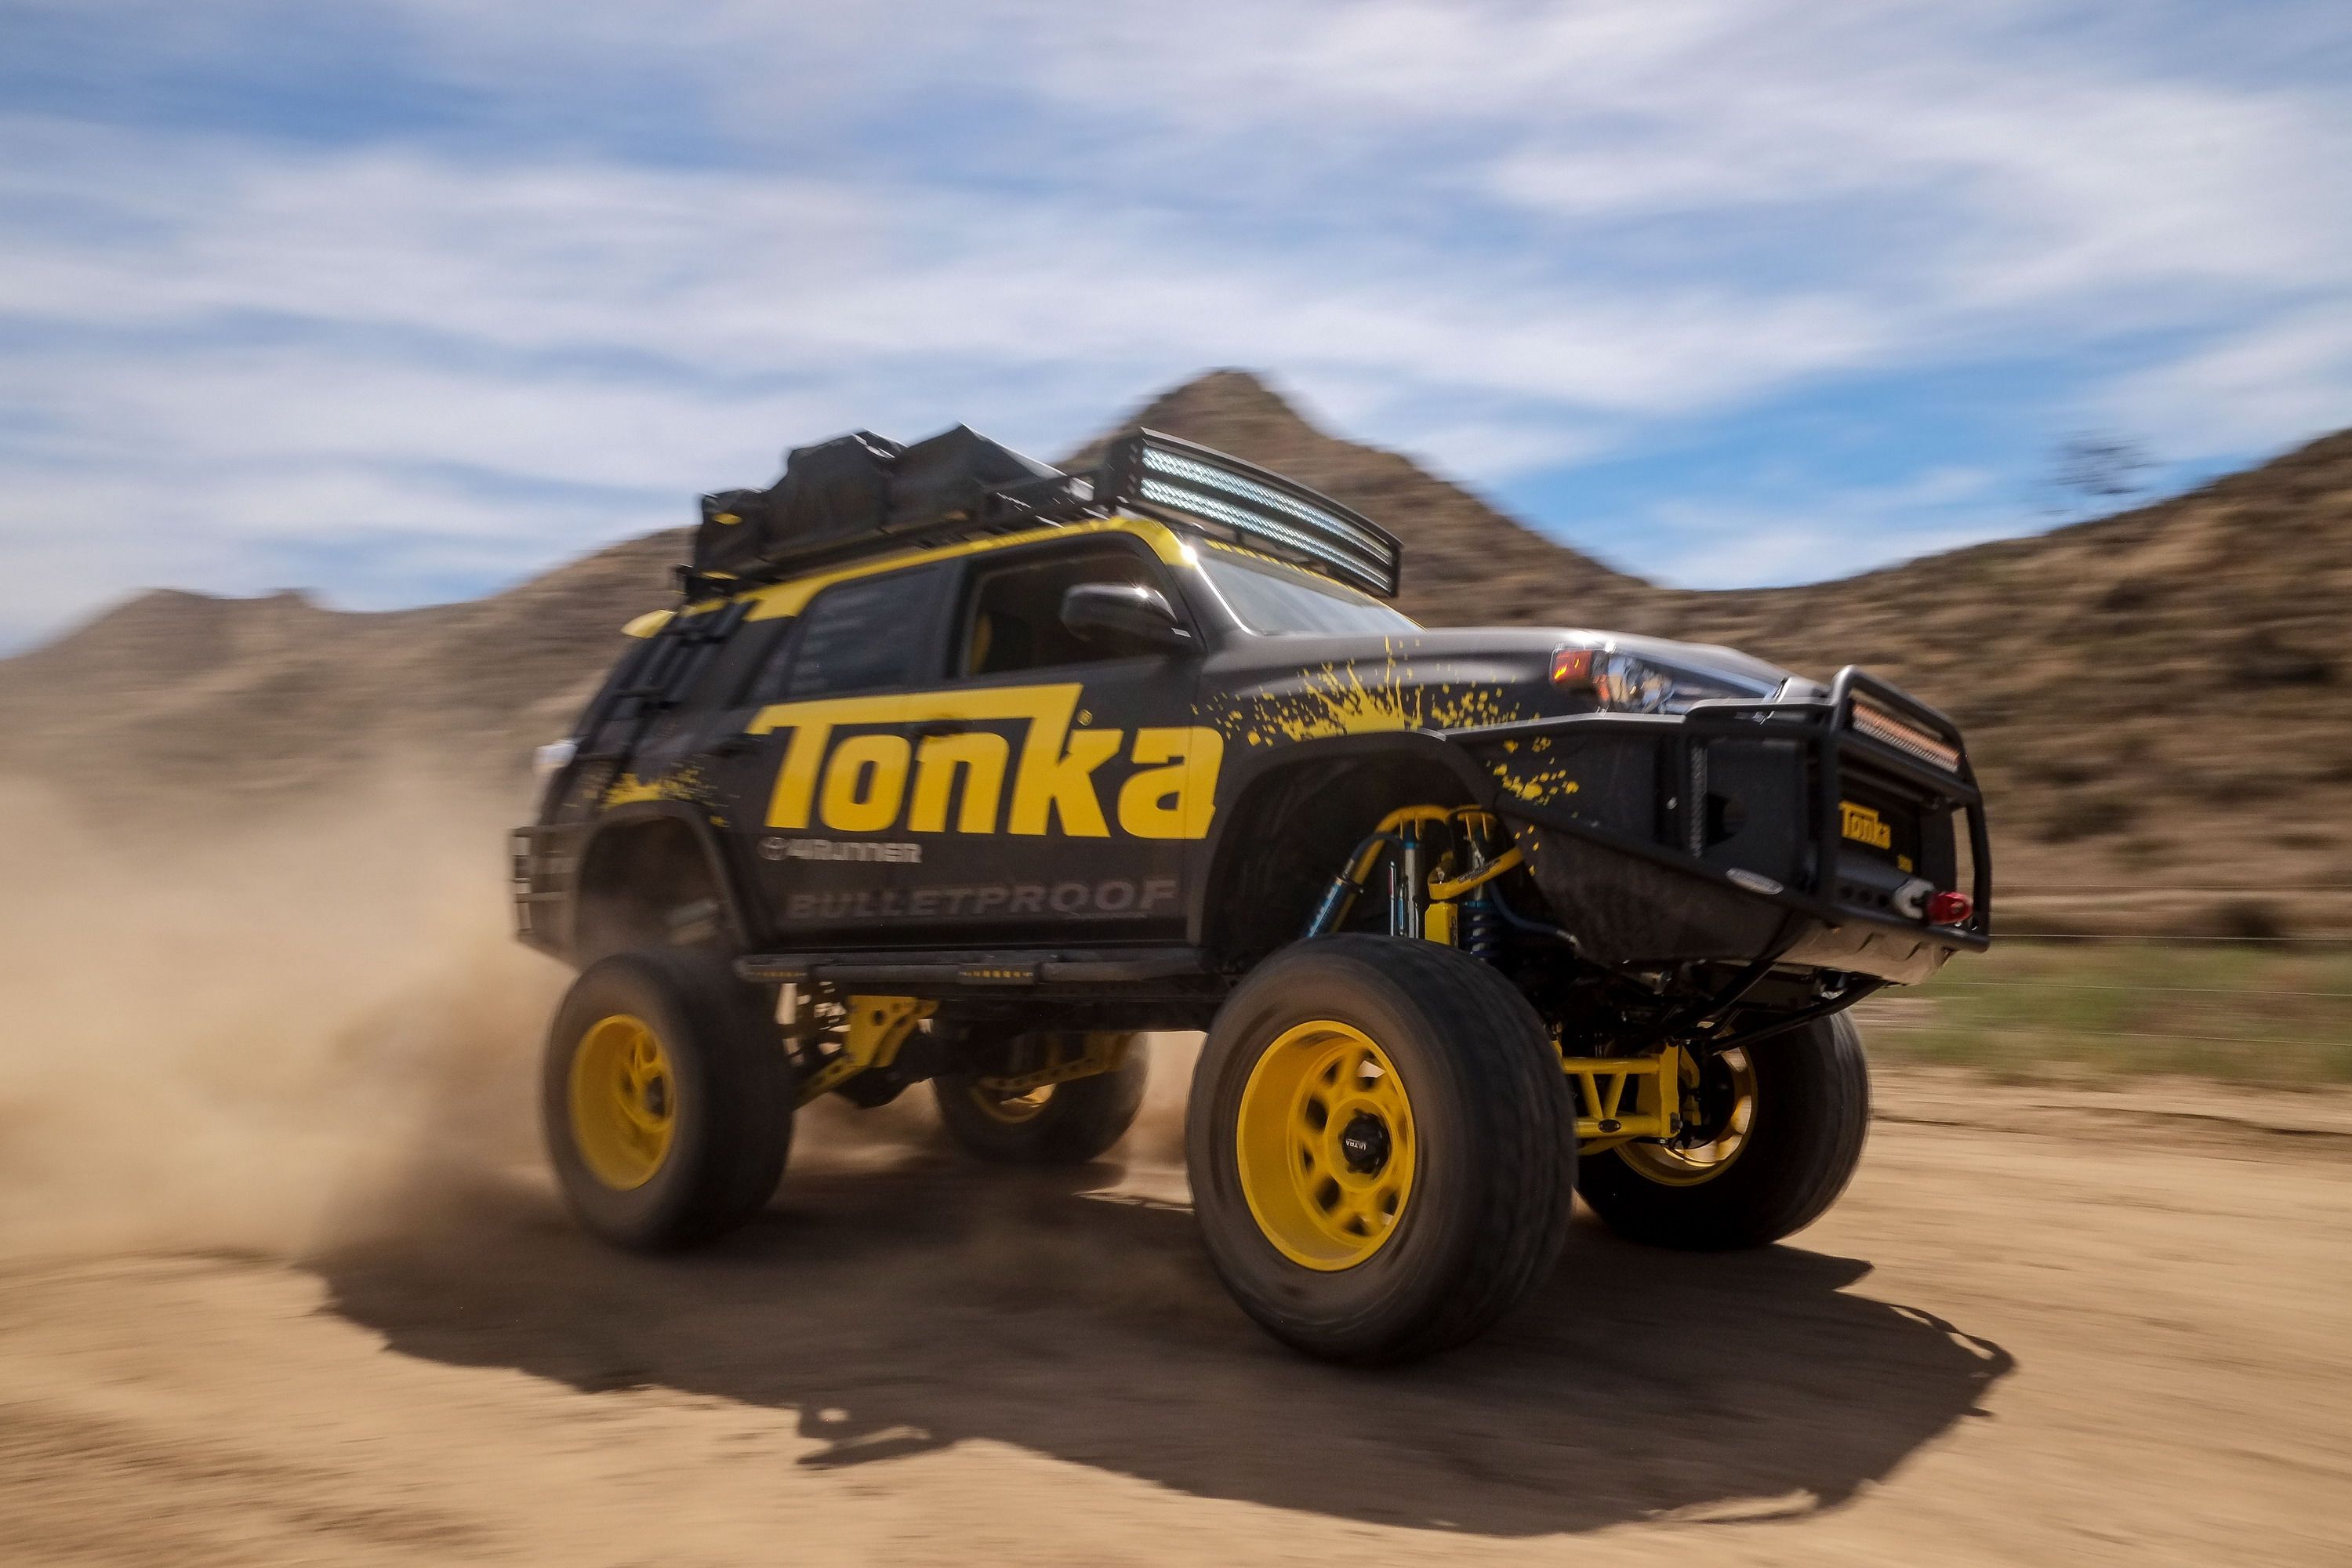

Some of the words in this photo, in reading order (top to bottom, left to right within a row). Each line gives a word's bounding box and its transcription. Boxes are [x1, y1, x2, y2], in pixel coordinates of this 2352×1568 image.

[746, 682, 1224, 839] Tonka
[1838, 800, 1890, 849] Tonka
[787, 879, 1175, 918] BULLETPROOF
